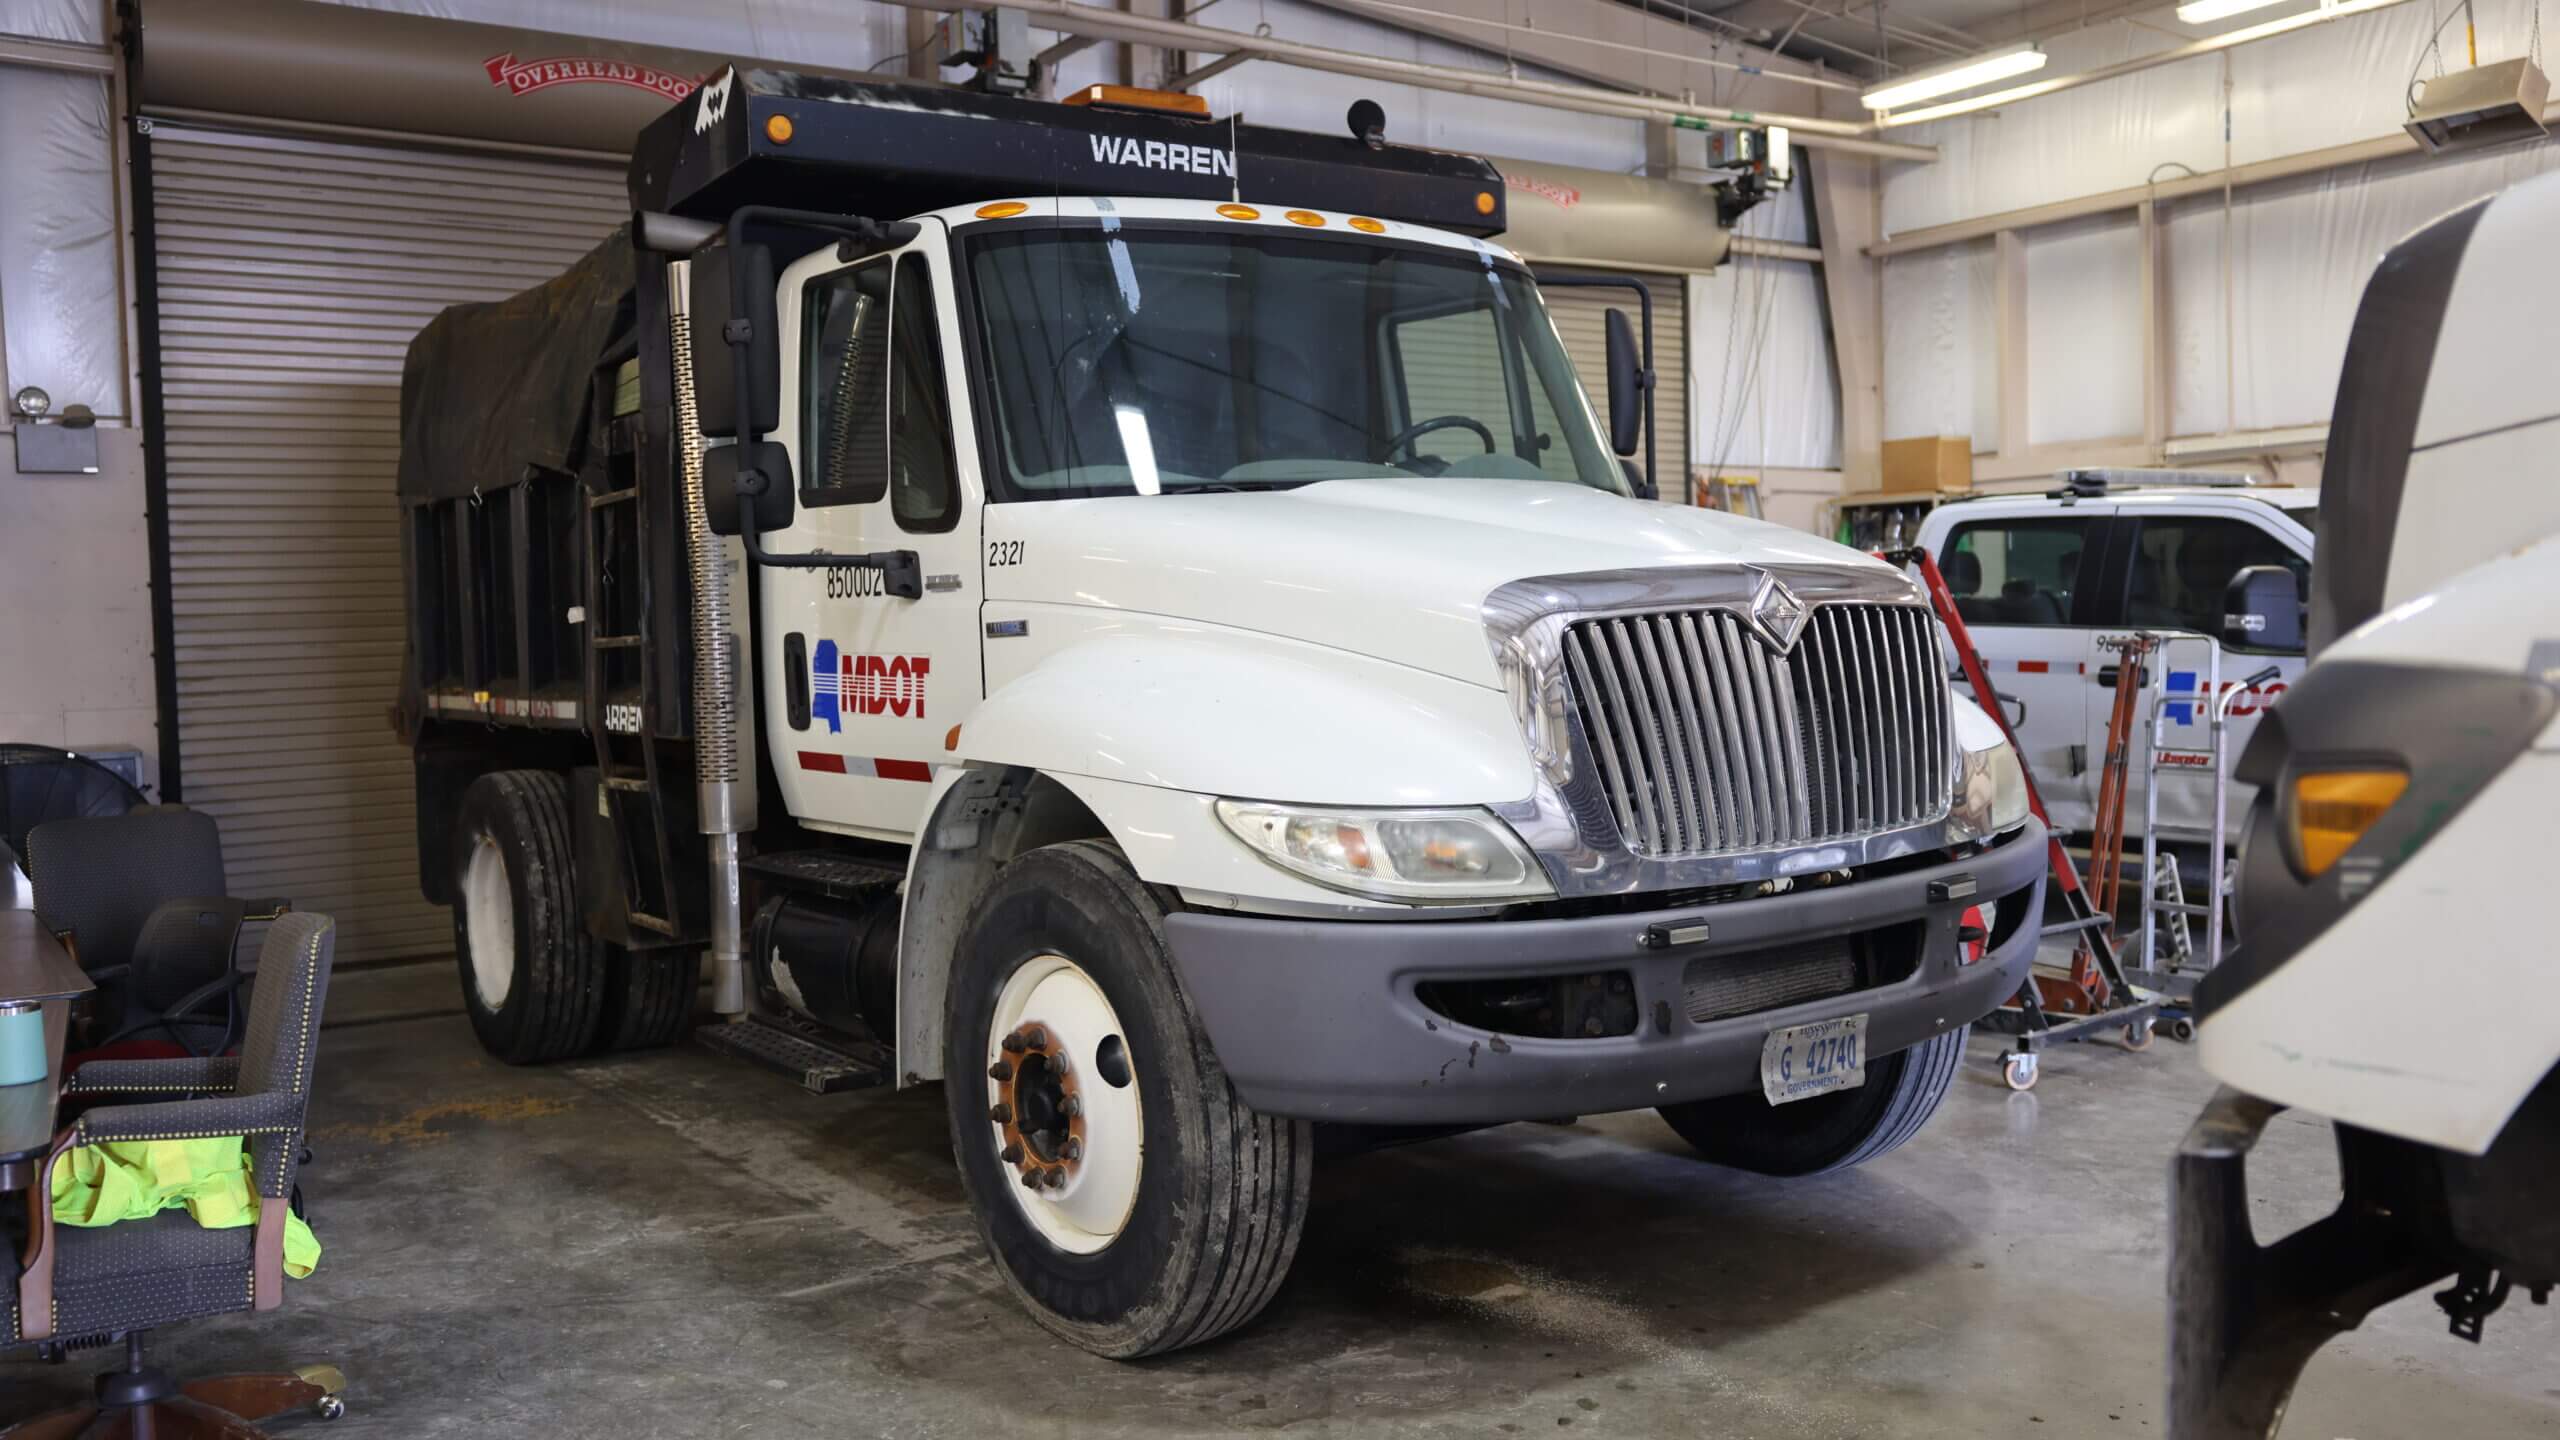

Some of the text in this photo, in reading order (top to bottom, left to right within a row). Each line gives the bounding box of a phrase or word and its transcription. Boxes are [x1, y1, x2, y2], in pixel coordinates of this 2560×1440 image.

[514, 61, 693, 98] OVERHEAD DOO
[1089, 134, 1237, 177] WARREN
[989, 541, 1024, 567] 2321
[841, 655, 930, 719] MDOT
[1781, 1033, 1856, 1081] G 42740
[1787, 1076, 1838, 1094] GOVERNMENT
